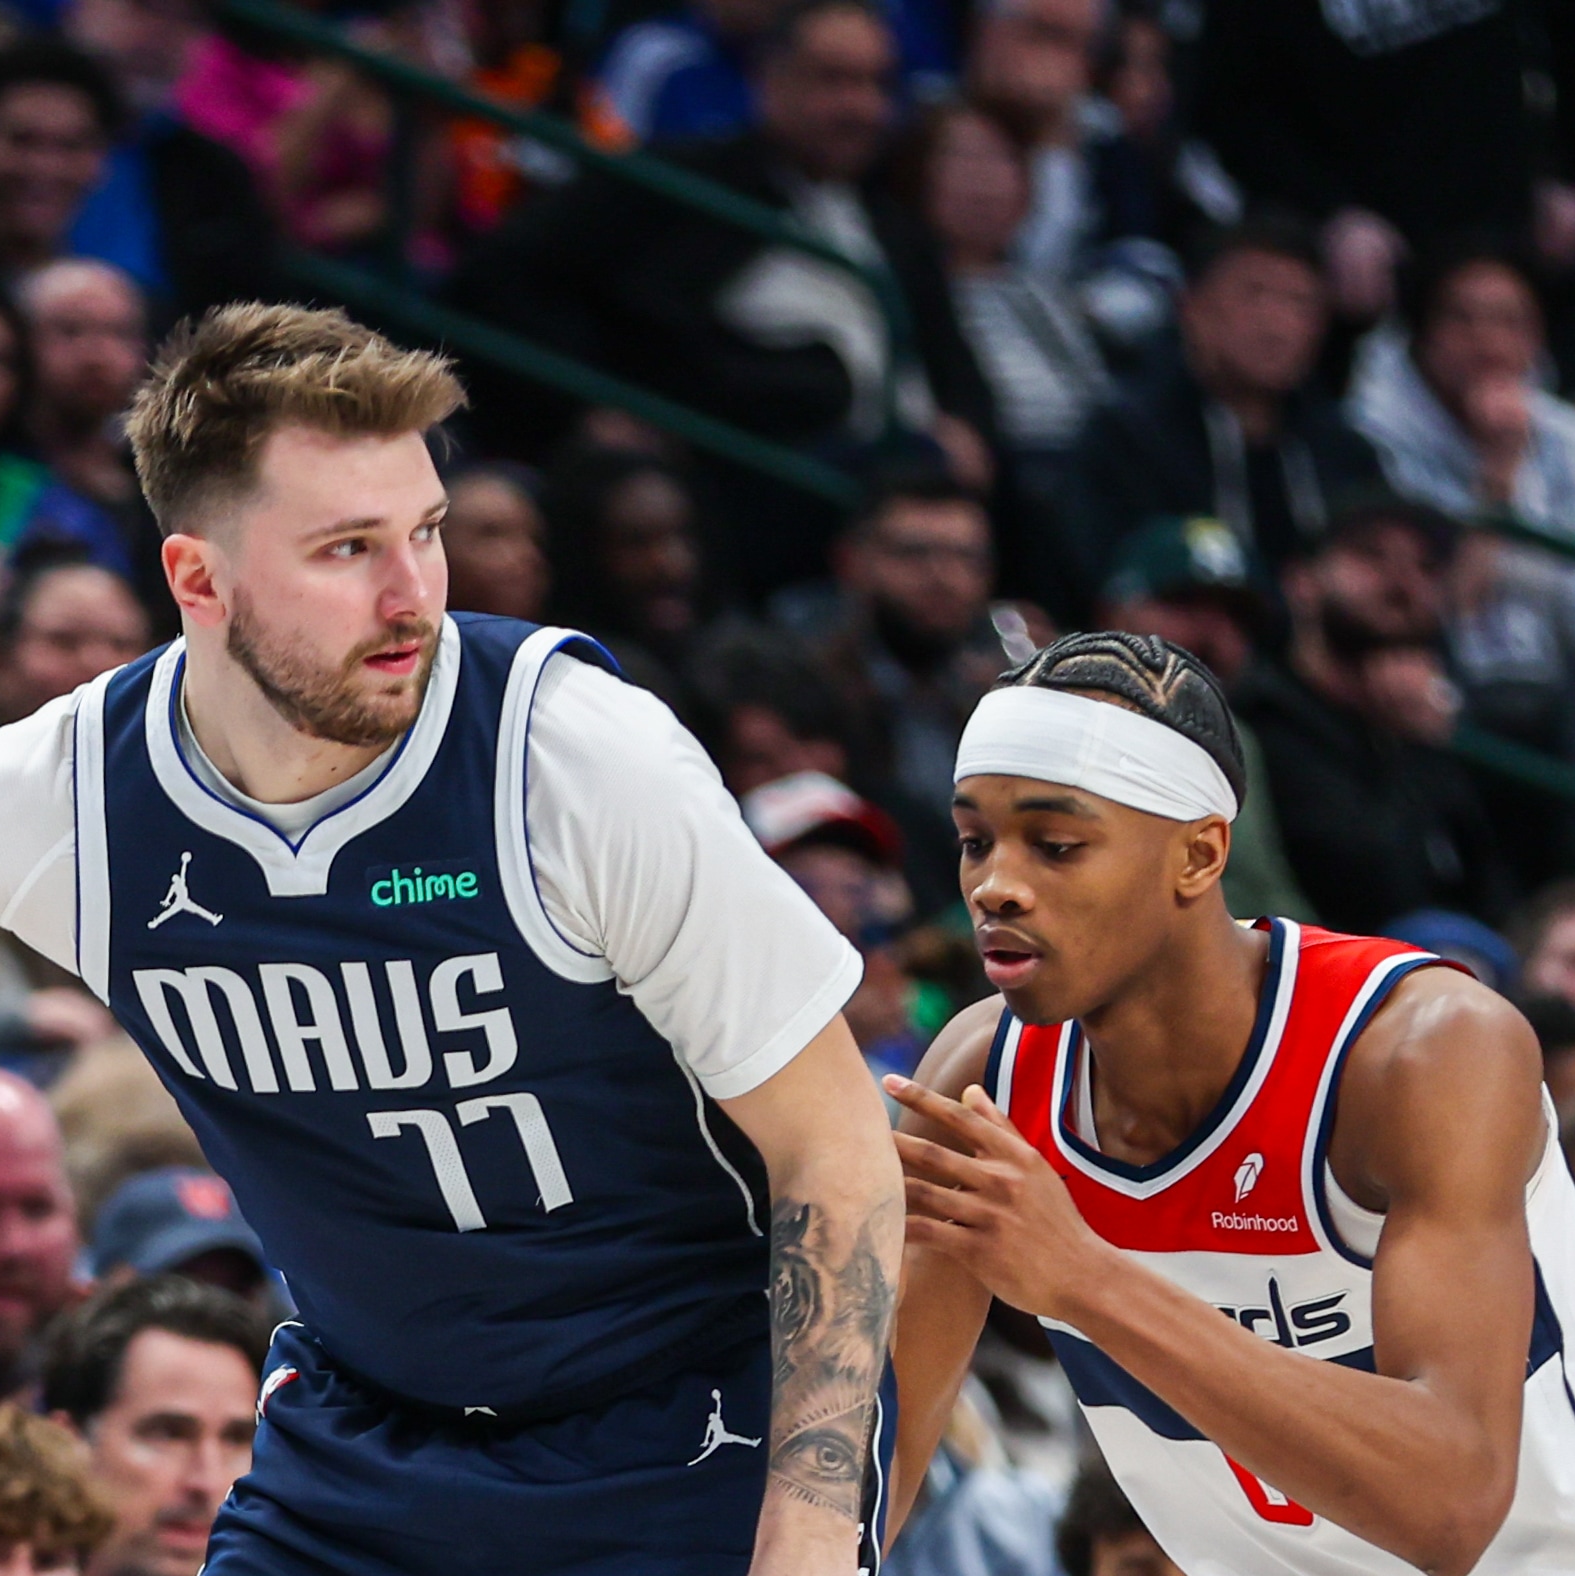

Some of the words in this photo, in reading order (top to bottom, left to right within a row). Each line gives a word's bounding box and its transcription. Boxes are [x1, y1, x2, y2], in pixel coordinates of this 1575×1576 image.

[370, 868, 479, 906] chime
[131, 952, 519, 1093] MAVS
[366, 1092, 574, 1233] 77
[1211, 1211, 1299, 1233] Robinhood
